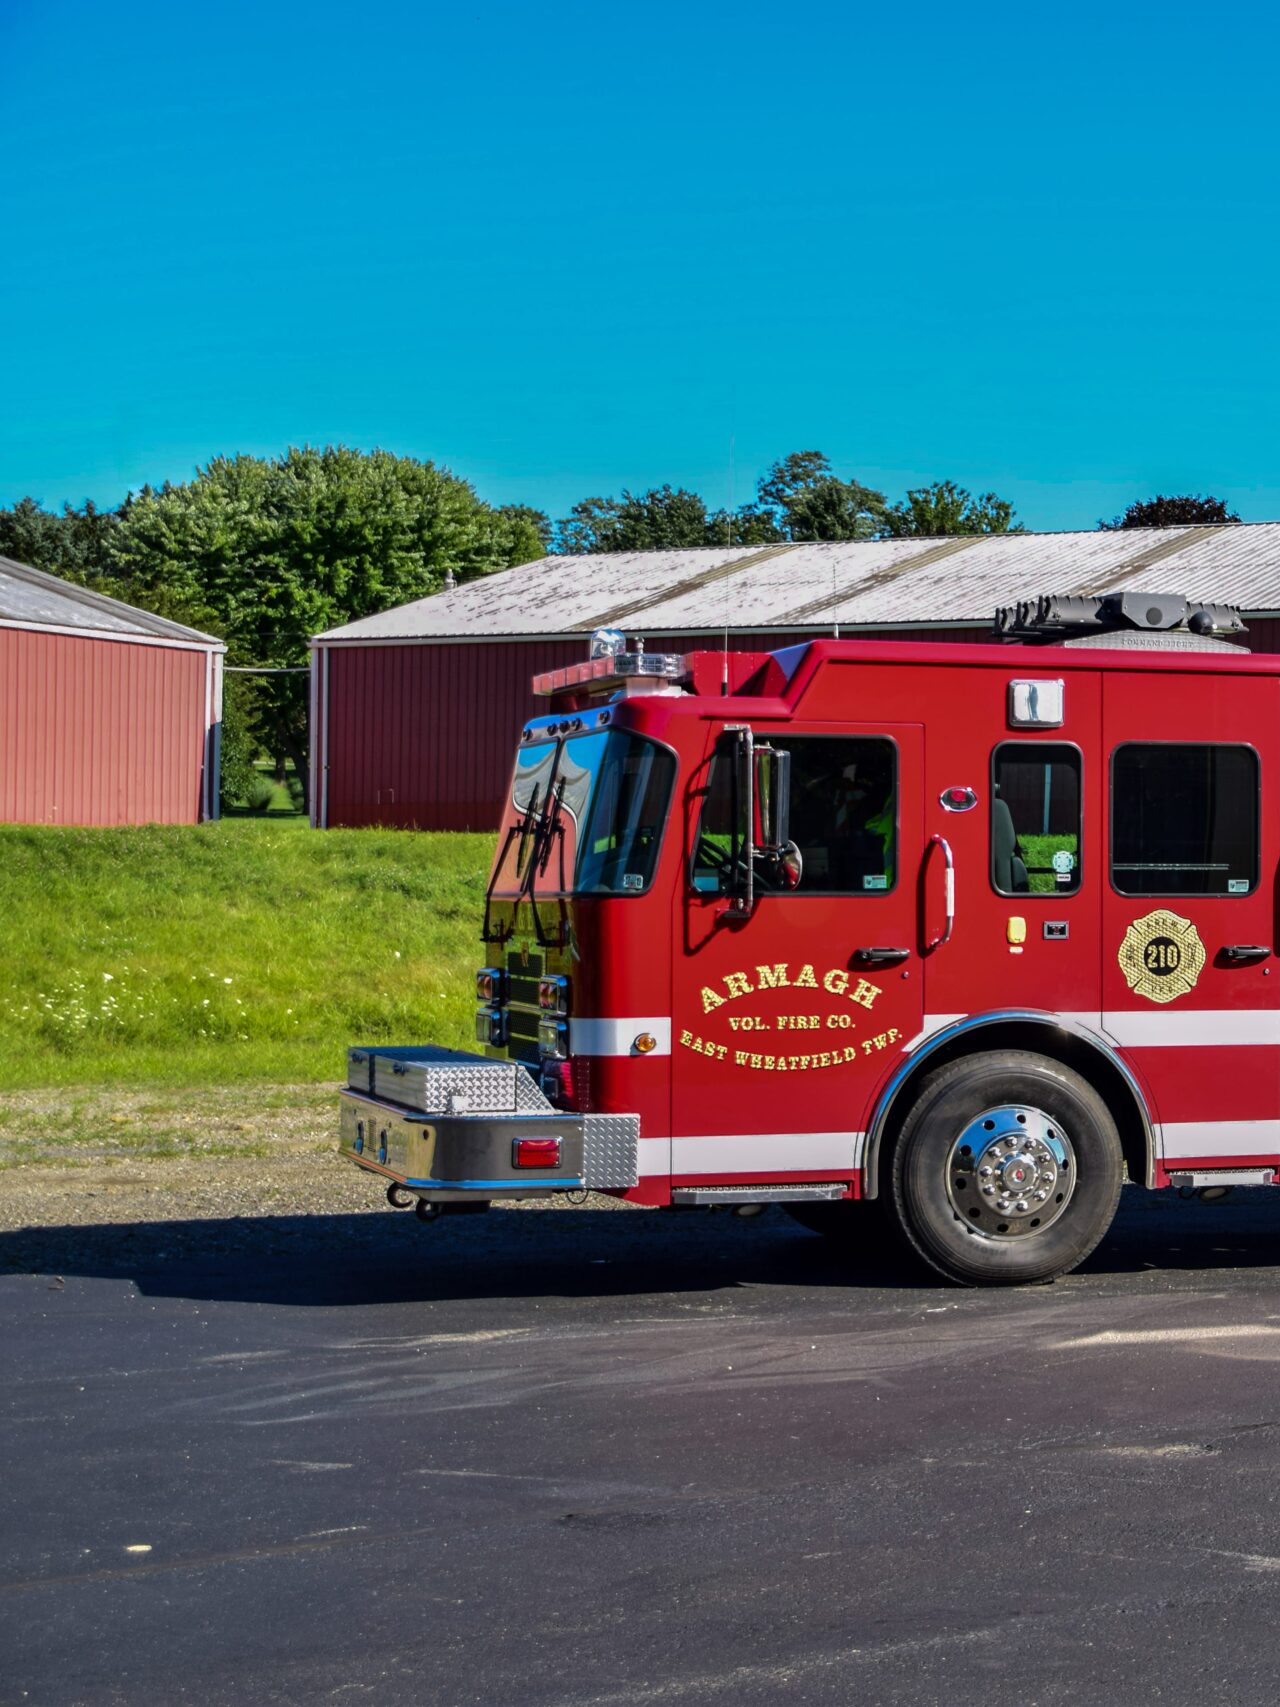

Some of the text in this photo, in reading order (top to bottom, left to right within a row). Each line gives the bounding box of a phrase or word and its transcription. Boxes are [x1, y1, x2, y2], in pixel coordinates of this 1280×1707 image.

[1147, 944, 1178, 969] 210
[700, 963, 883, 1014] ARMAGH
[728, 1014, 856, 1031] VOL. FIRE CO.
[679, 1027, 903, 1072] EAST WHEATFIELD TWP.
